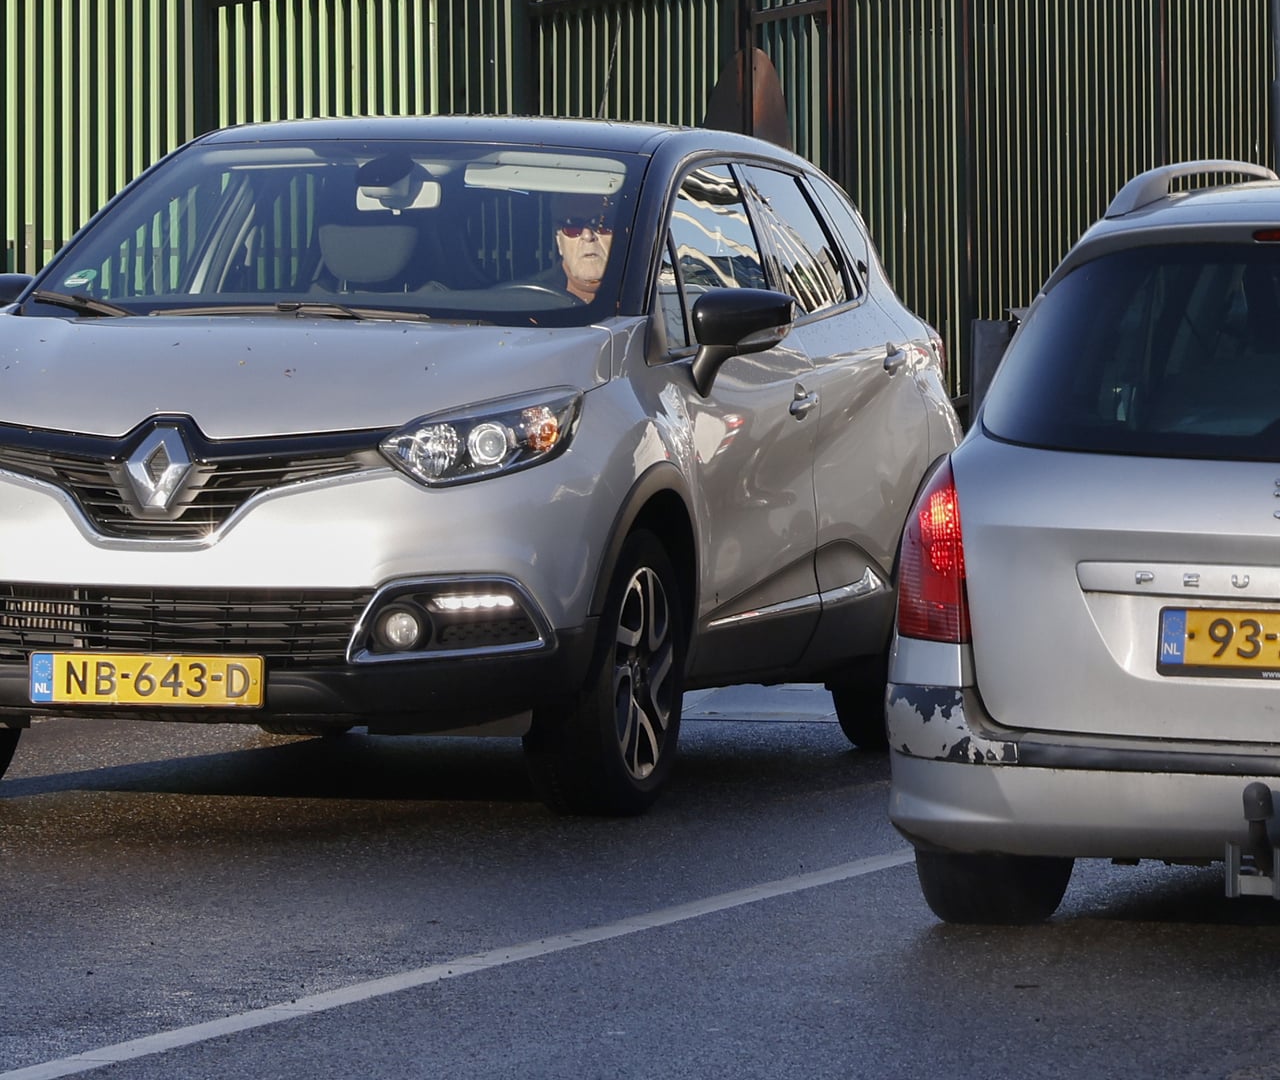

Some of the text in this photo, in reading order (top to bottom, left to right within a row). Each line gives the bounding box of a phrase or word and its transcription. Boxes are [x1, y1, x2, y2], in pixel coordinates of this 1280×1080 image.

[1163, 639, 1181, 655] NL
[35, 660, 250, 698] NL NB-643-D
